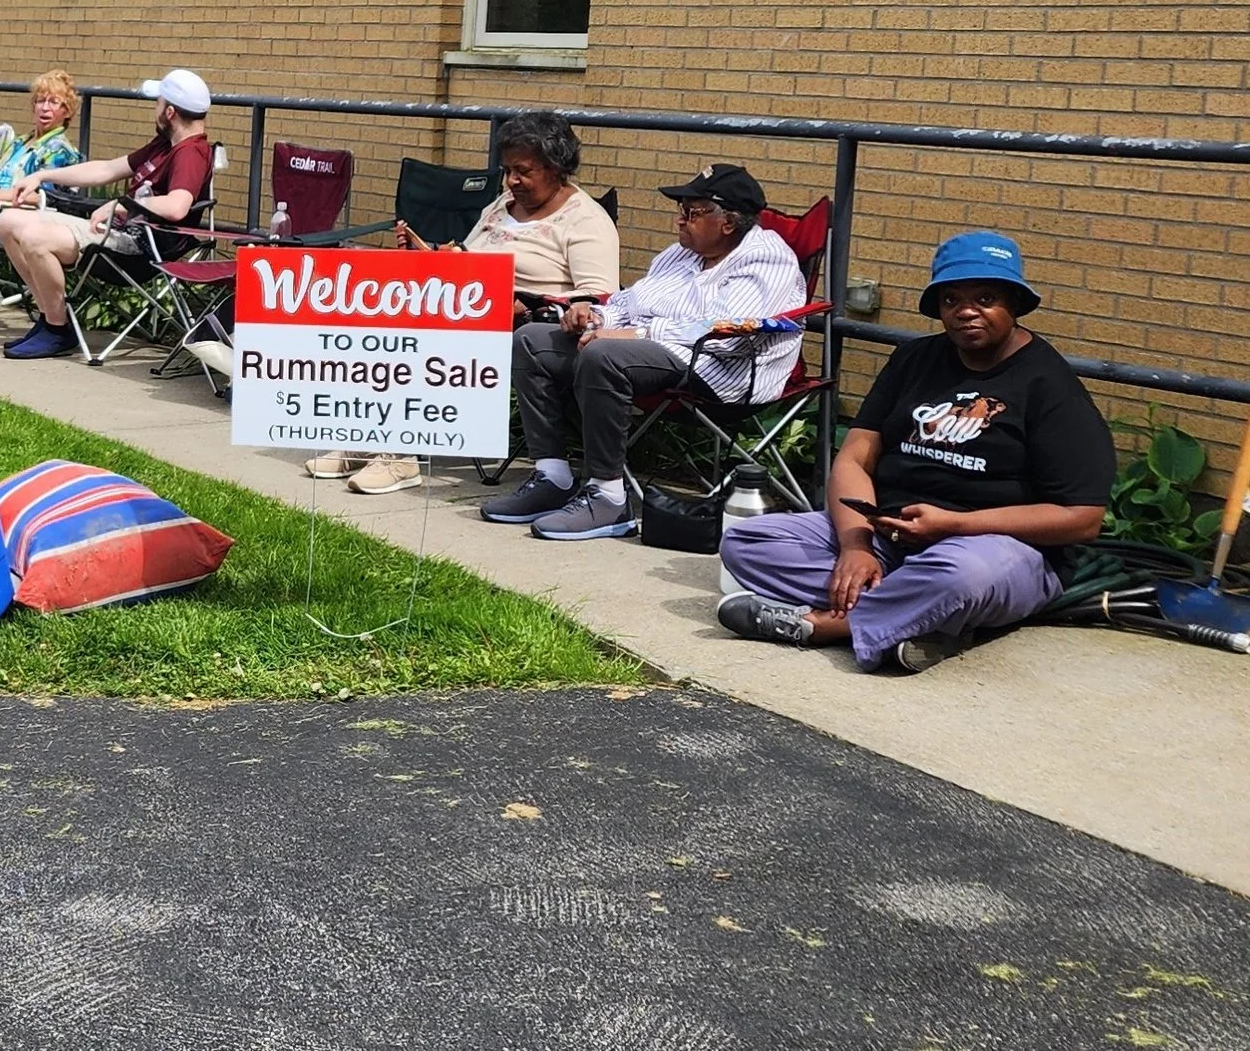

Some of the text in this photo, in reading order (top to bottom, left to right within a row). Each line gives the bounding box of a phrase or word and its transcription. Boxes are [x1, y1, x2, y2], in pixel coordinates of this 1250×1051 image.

[290, 156, 336, 174] CEDAR TRAIL
[252, 253, 492, 321] Welcome
[318, 334, 418, 353] TO OUR
[241, 351, 499, 393] Rummage Sale
[276, 391, 458, 426] $5 Entry Fee
[912, 402, 984, 444] Cow
[268, 424, 465, 451] (THURSDAY ONLY)
[900, 441, 987, 472] WHISPERER
